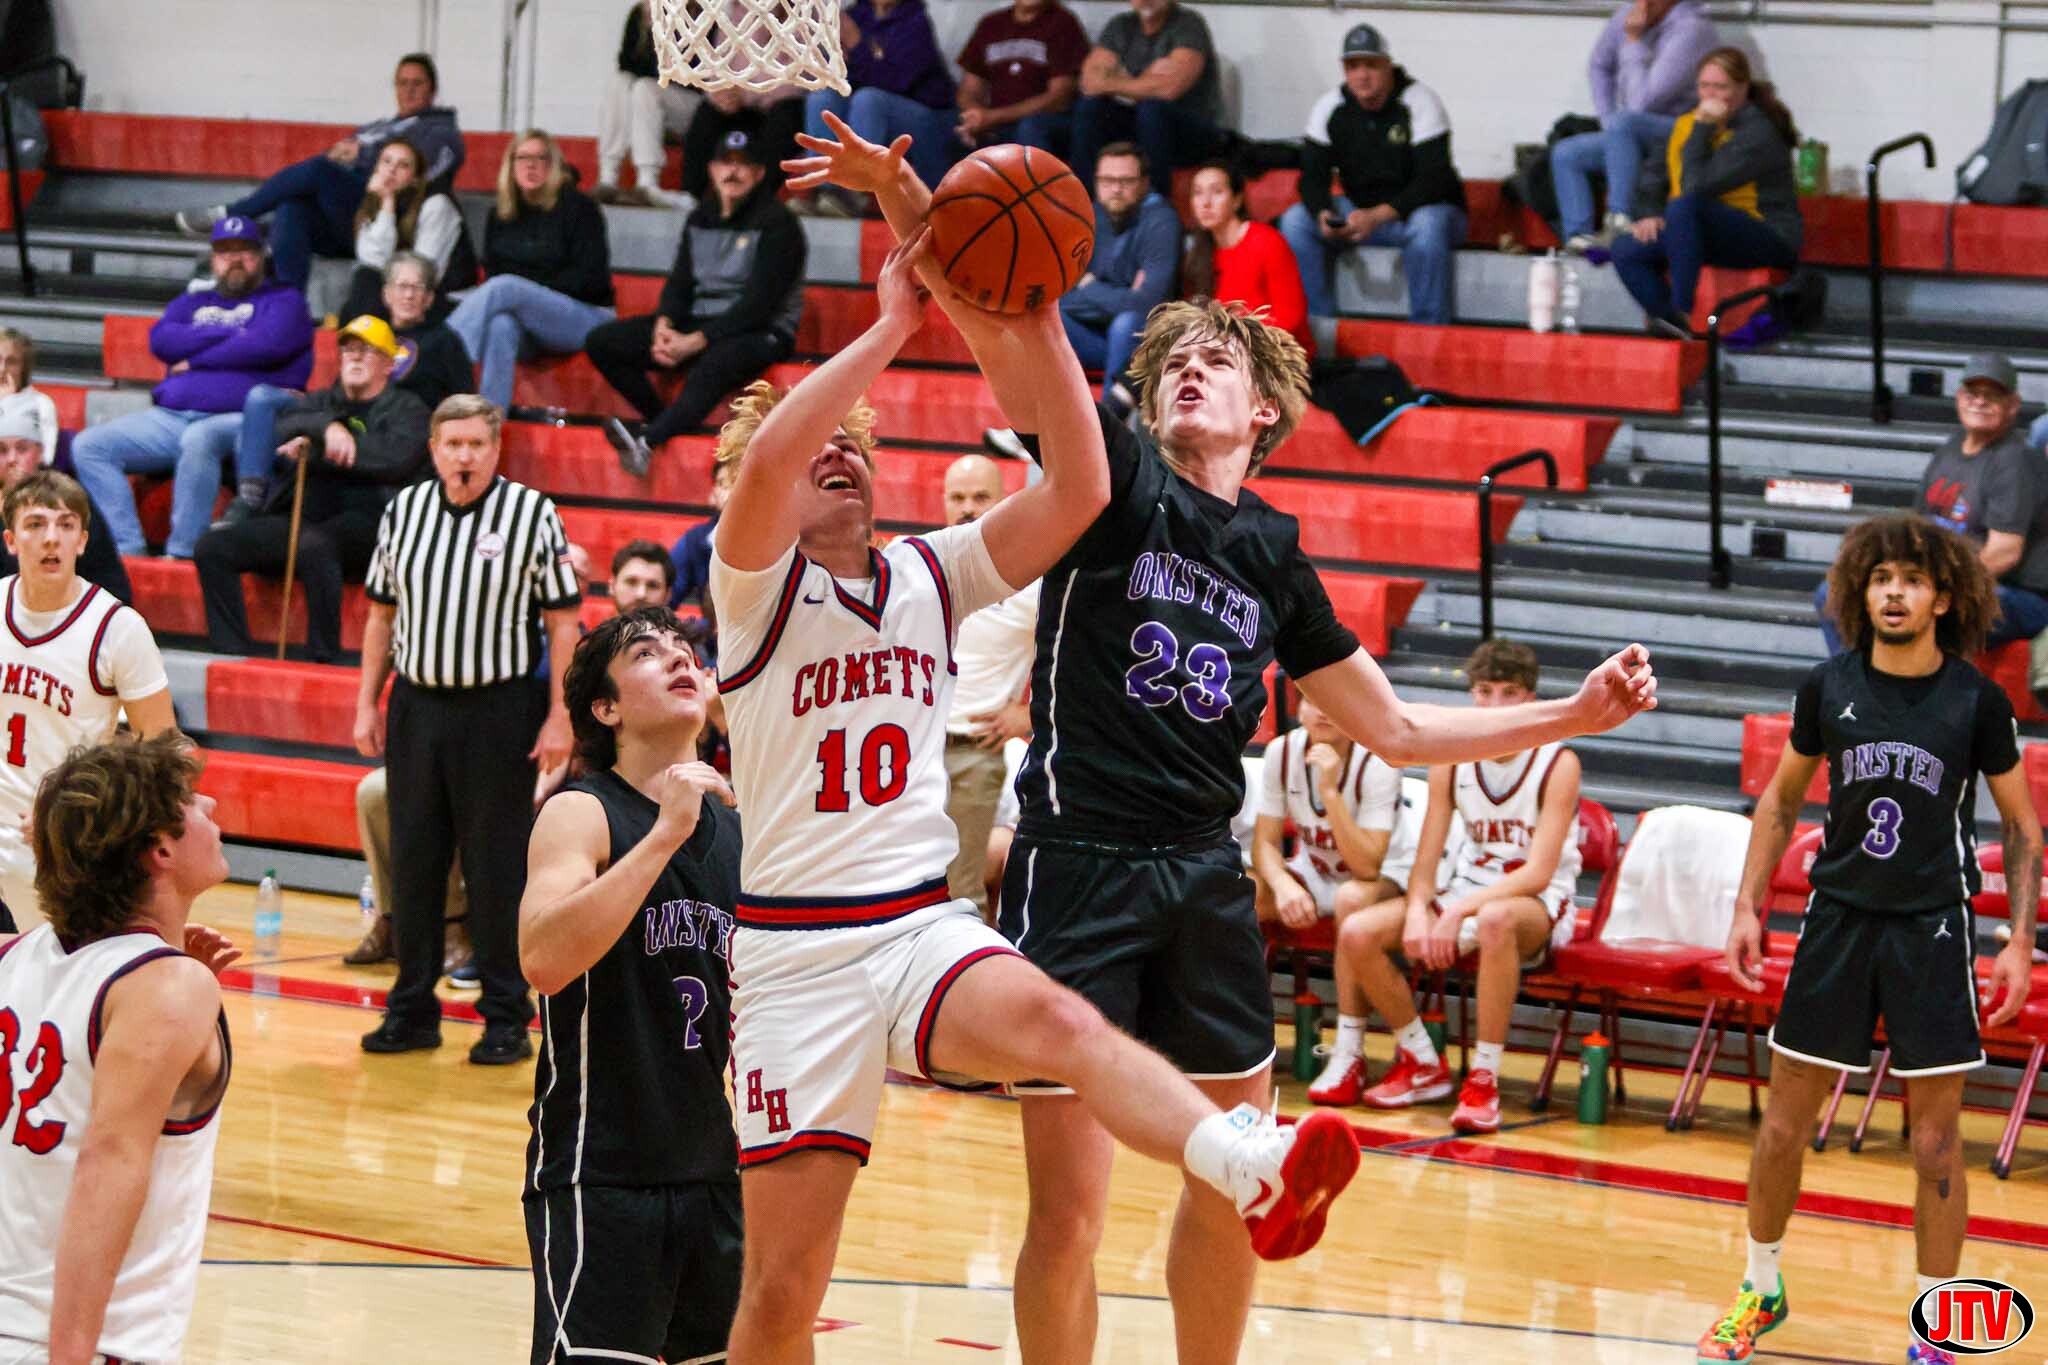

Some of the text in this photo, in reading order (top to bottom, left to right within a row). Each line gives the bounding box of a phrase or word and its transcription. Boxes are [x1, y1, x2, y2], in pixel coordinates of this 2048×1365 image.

[1128, 552, 1259, 649] ONSTED
[0, 663, 74, 717] METS
[793, 646, 936, 717] COMETS
[1126, 621, 1232, 722] 23
[7, 712, 27, 768] 1
[816, 723, 911, 812] 10
[1842, 741, 1944, 796] ONSTED
[1862, 797, 1904, 859] 3
[645, 899, 734, 961] ONSTE
